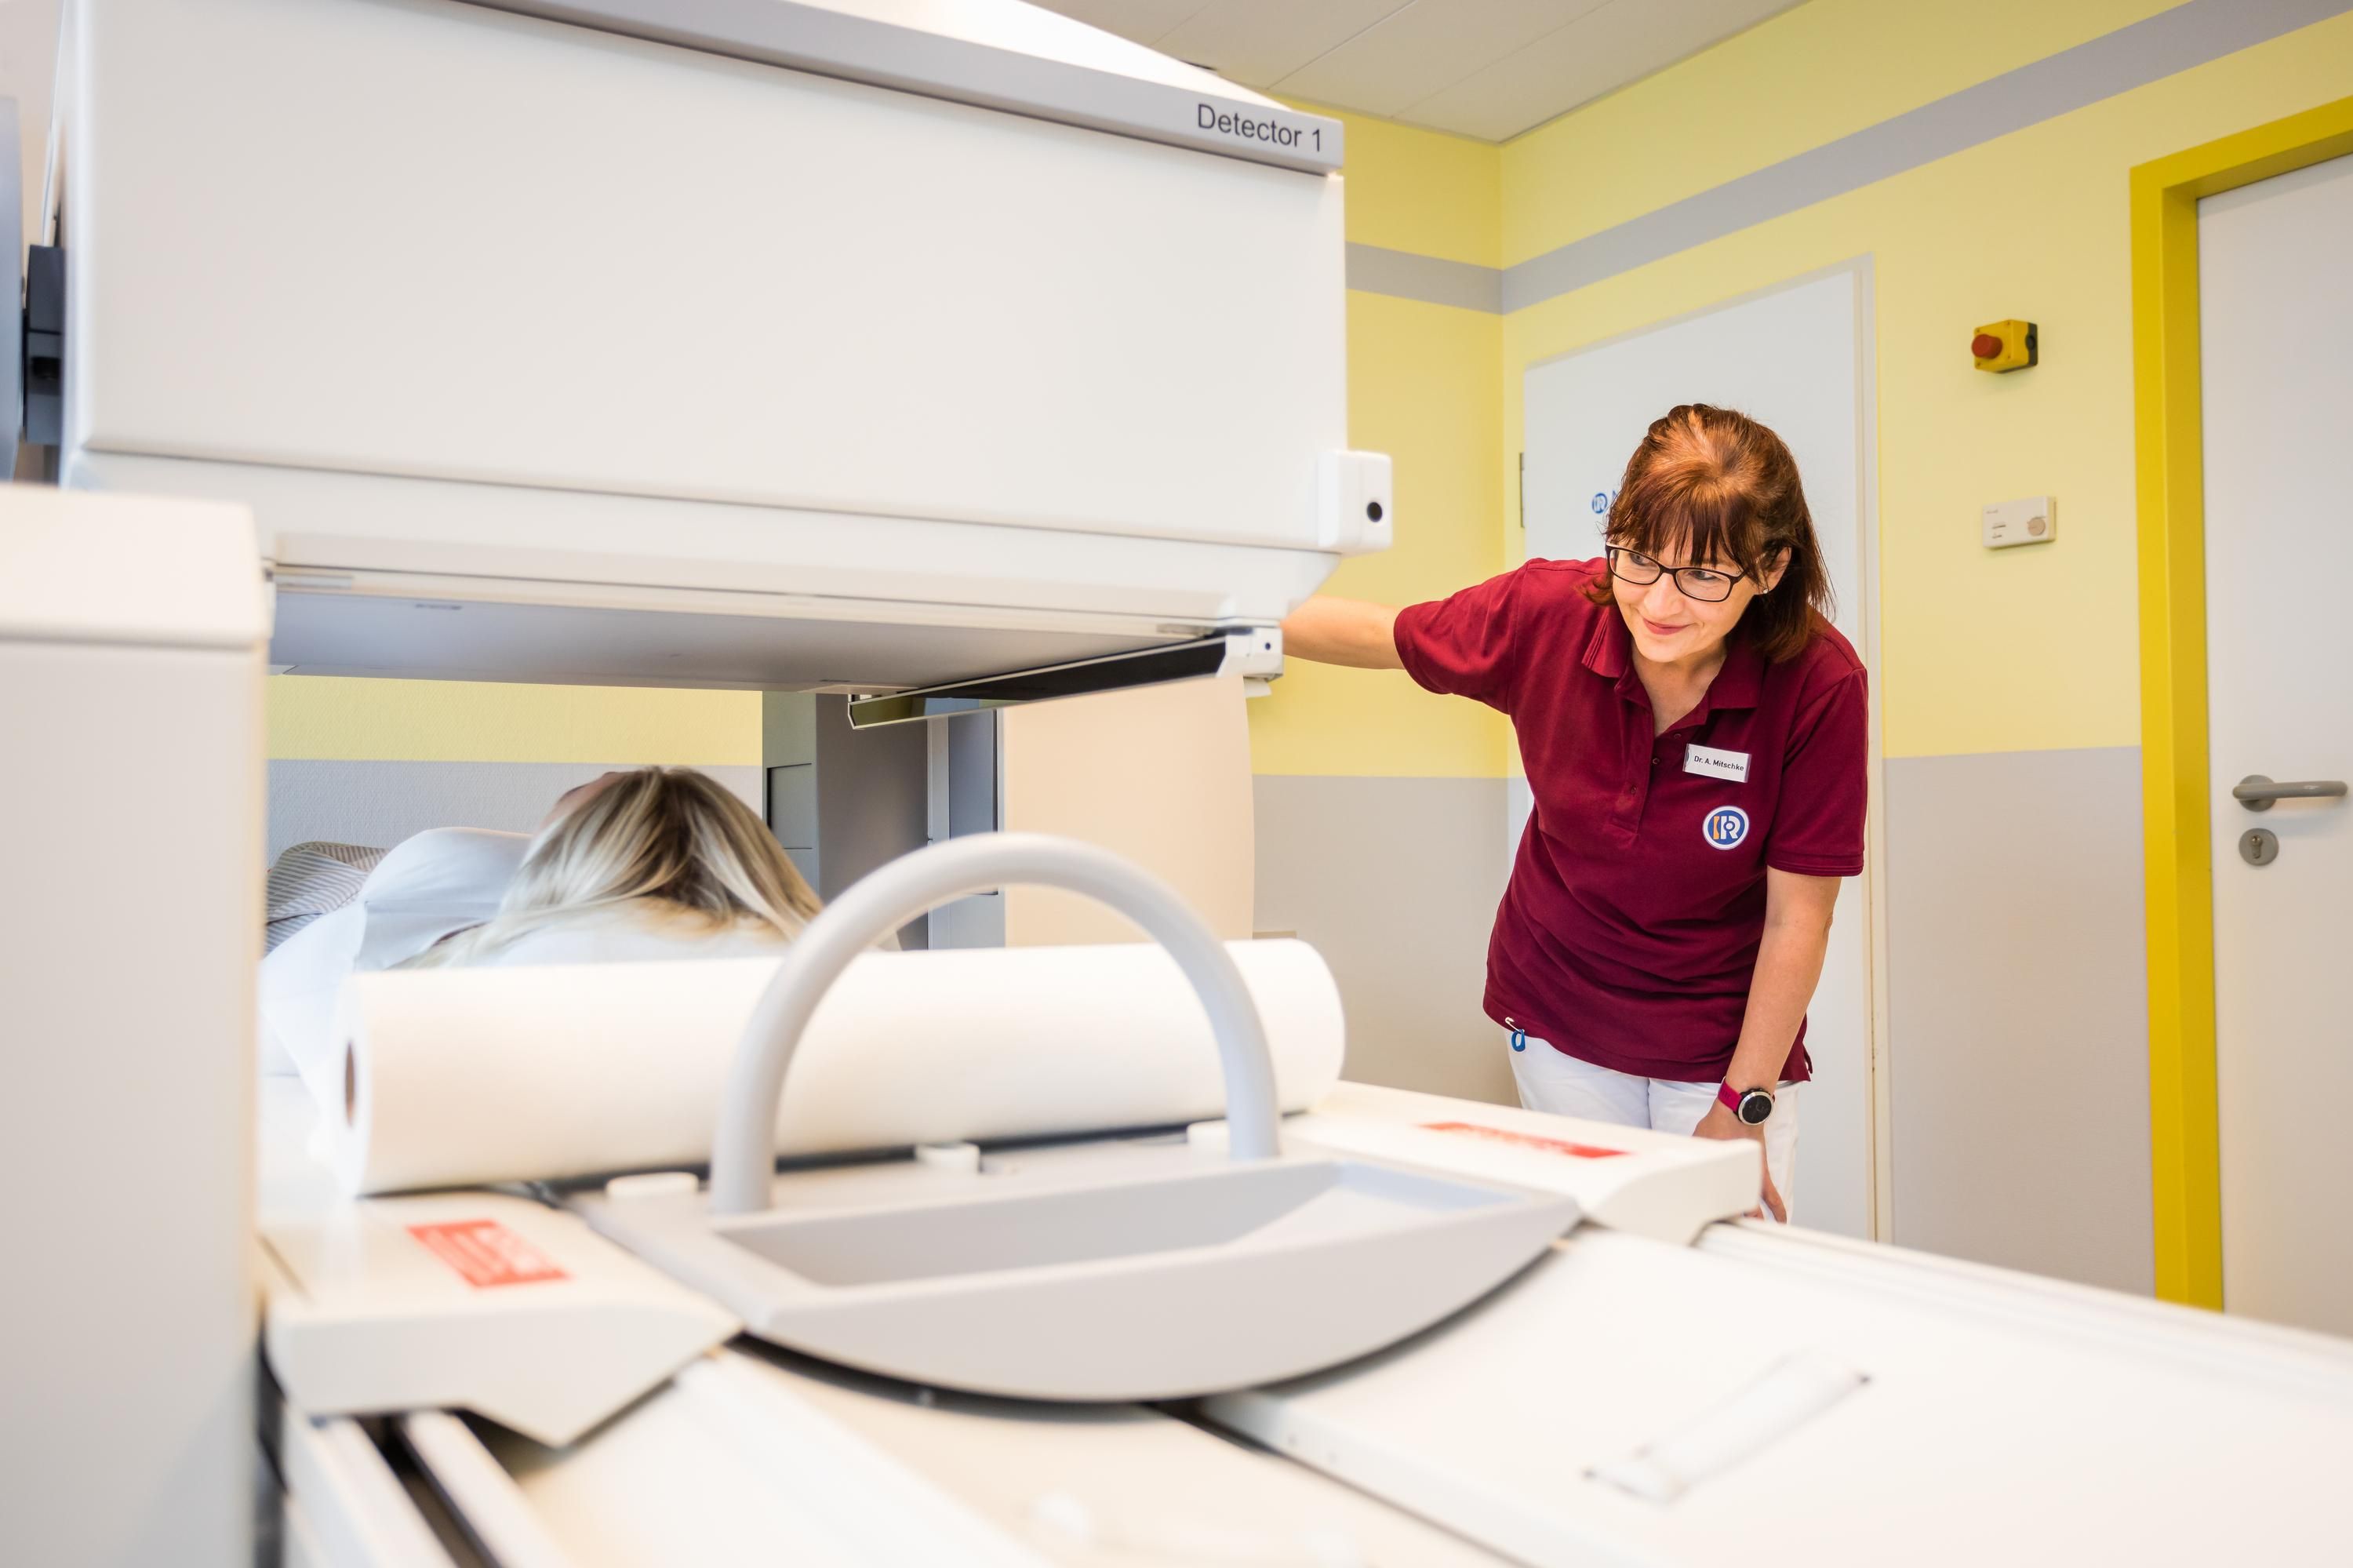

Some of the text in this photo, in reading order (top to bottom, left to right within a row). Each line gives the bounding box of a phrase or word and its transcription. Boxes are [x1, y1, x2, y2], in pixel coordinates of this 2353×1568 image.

[1198, 104, 1321, 152] Detector 1
[1712, 760, 1744, 771] Mitschke
